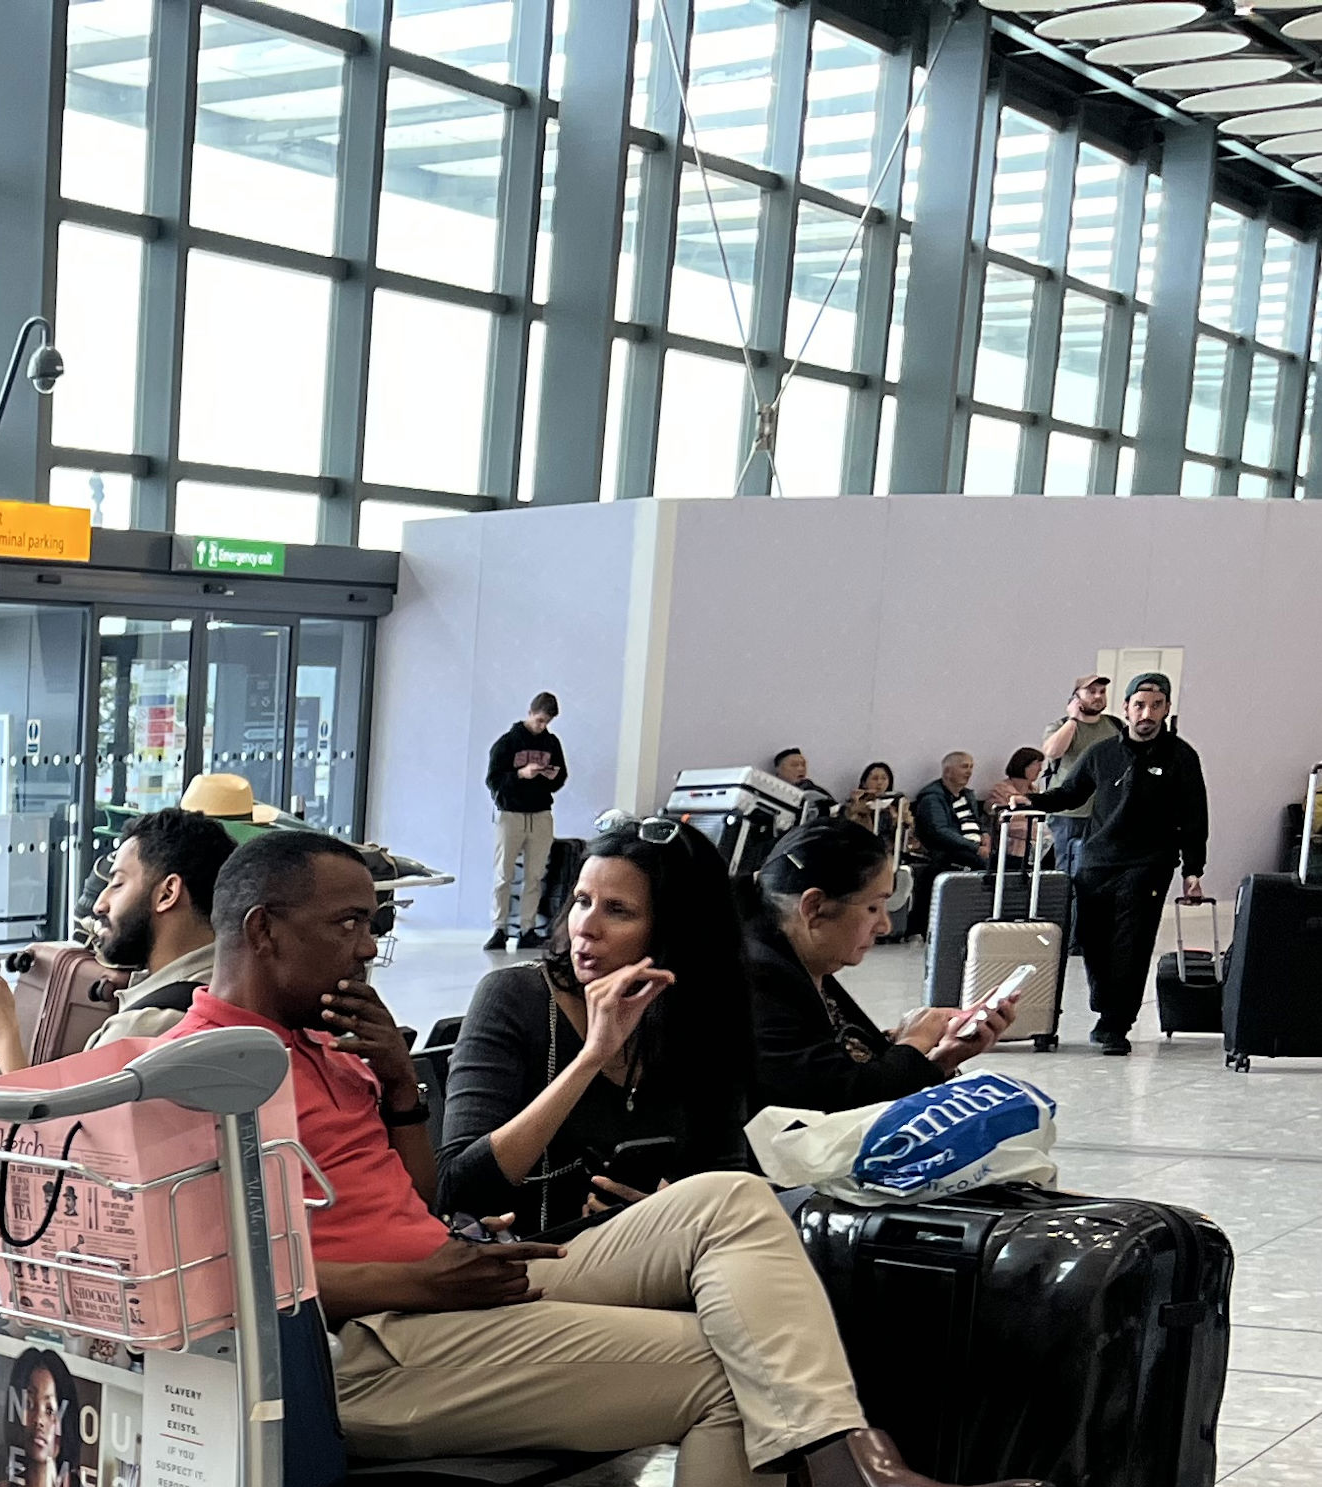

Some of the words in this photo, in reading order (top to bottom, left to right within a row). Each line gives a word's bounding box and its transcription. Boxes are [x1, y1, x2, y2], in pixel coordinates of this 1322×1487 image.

[28, 535, 64, 553] parking
[165, 1384, 202, 1400] SLAVERY
[171, 1403, 195, 1417] STILL
[51, 1399, 131, 1453] YOU
[167, 1420, 200, 1436] EXISTS.
[167, 1446, 176, 1455] IF
[178, 1449, 195, 1460] YOU
[156, 1460, 193, 1477] SUSPECT
